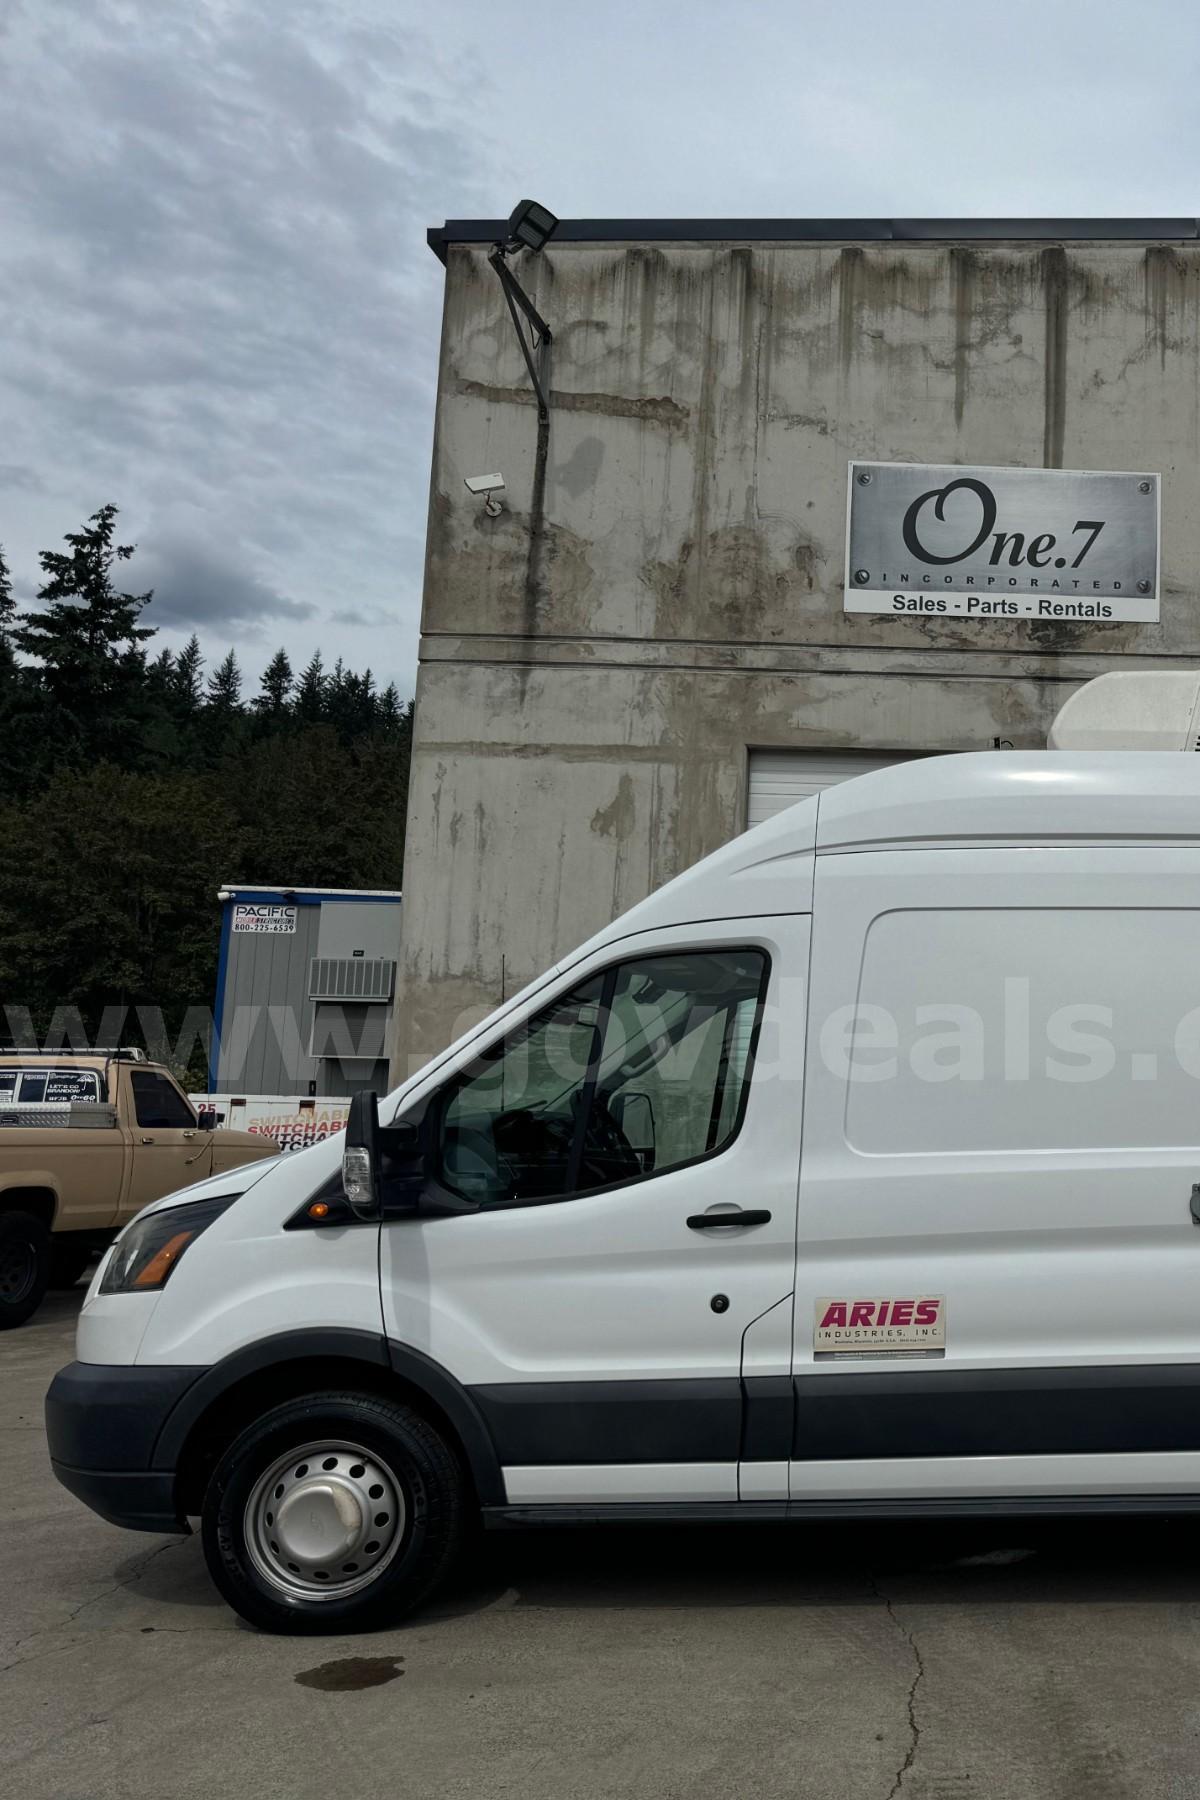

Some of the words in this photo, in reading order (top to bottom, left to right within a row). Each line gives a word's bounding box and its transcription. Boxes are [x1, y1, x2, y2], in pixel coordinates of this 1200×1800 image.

[903, 477, 1106, 569] One.7
[882, 573, 1122, 590] INCORPORATED
[892, 594, 947, 613] Sales
[967, 597, 1018, 615] Parts
[1038, 600, 1112, 618] Rentals
[235, 924, 294, 932] 800-225-6539
[820, 1300, 940, 1328] ARIES
[916, 1328, 942, 1336] INC.
